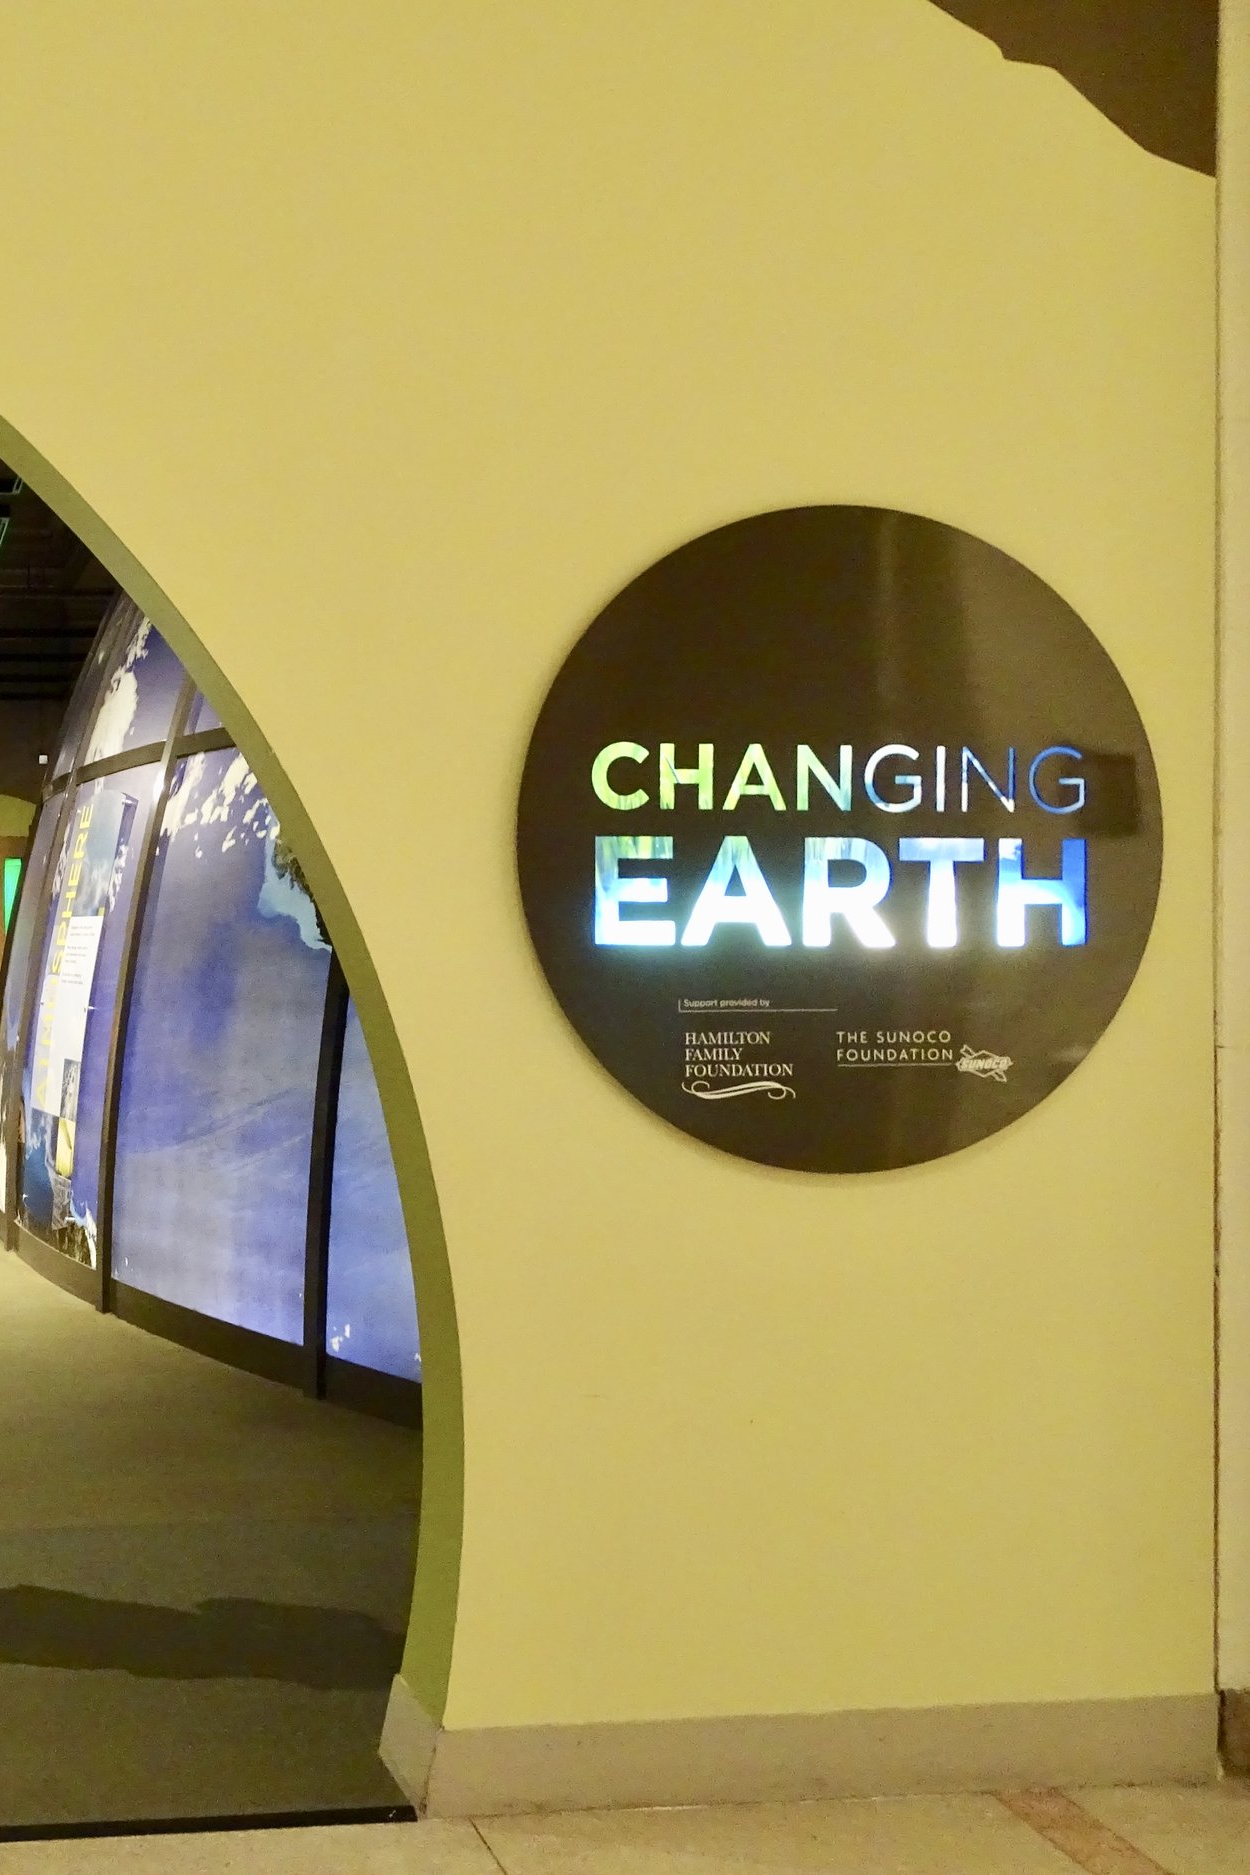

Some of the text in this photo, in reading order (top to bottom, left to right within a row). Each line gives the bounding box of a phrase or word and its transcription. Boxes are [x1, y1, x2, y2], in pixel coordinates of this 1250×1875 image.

[591, 741, 1086, 814] CHANGING
[594, 835, 1087, 948] EARTH
[683, 998, 770, 1008] Support provided by
[685, 1031, 771, 1045] HAMILTON
[836, 1030, 951, 1043] THE SUNOCO
[685, 1048, 743, 1061] FAMILY
[836, 1048, 953, 1061] FOUNDATION
[685, 1063, 794, 1077] FOUNDATION
